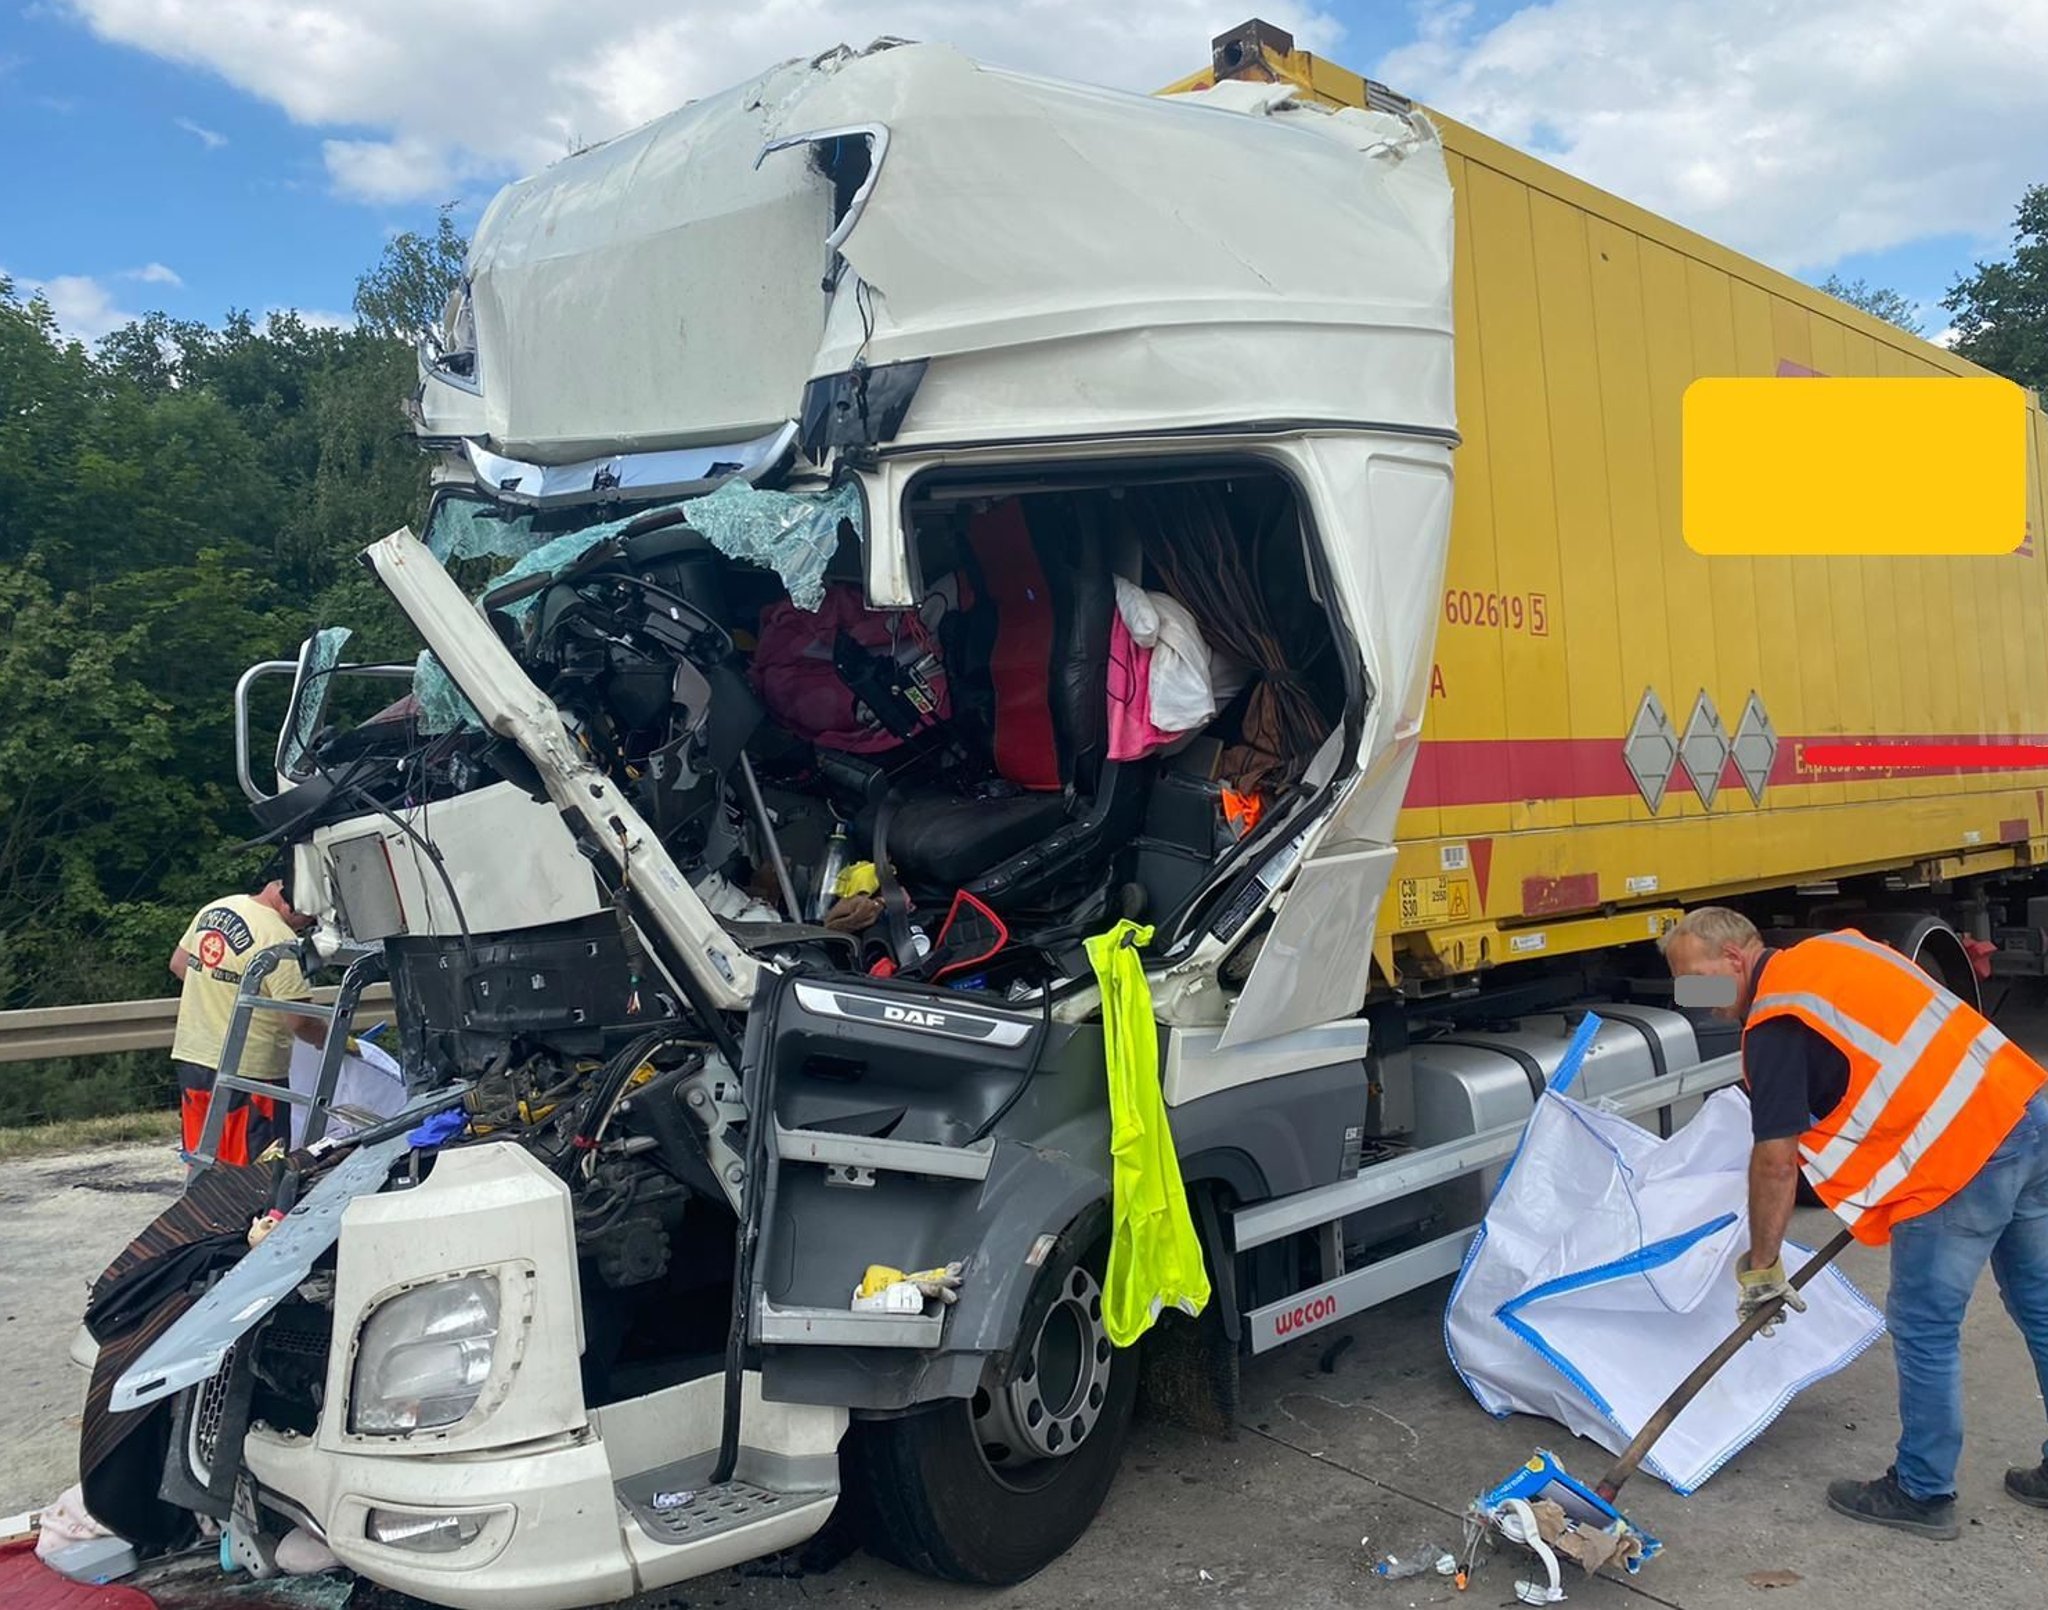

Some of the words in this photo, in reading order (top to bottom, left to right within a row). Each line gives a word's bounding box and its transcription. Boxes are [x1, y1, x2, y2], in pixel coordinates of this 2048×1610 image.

[1445, 589, 1524, 629] 602619
[1532, 598, 1544, 631] 5
[884, 1006, 945, 1026] DAF
[1275, 1295, 1336, 1335] wecon
